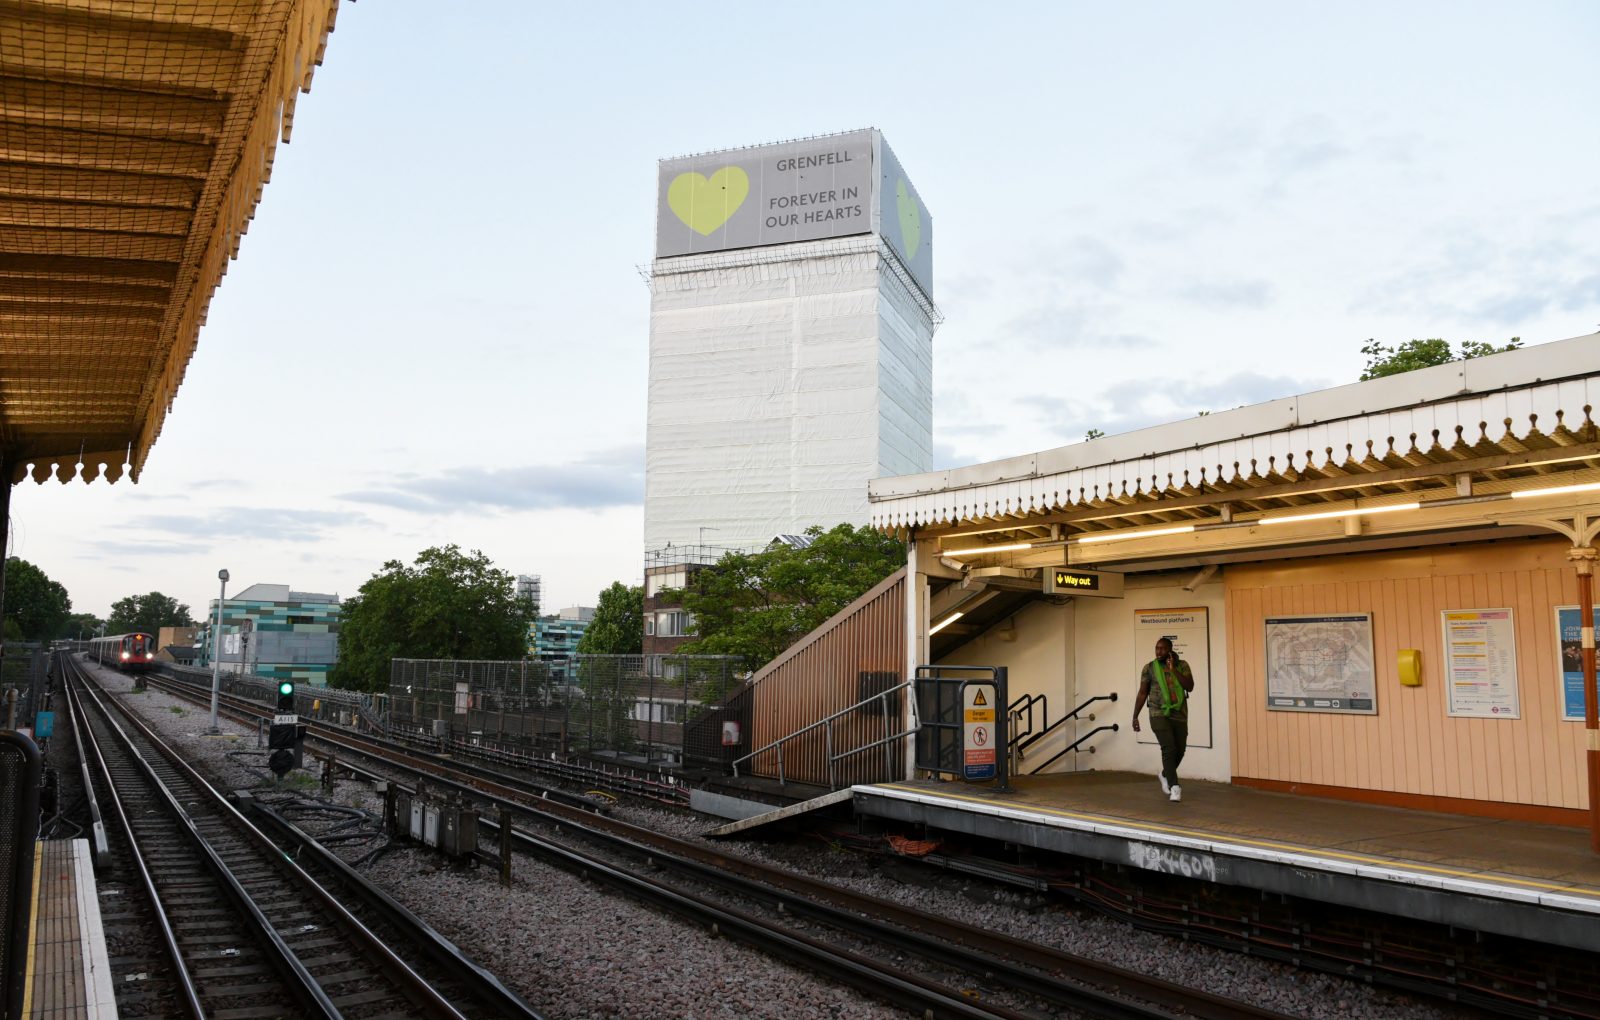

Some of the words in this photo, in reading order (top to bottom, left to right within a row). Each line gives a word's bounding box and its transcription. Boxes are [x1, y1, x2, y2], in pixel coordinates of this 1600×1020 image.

[777, 151, 853, 171] GRENFELL
[769, 190, 836, 209] FOREVER
[842, 186, 858, 199] IN
[765, 213, 800, 228] OUR
[804, 205, 863, 223] HEARTS
[1064, 575, 1079, 587] Way
[1079, 577, 1091, 586] out
